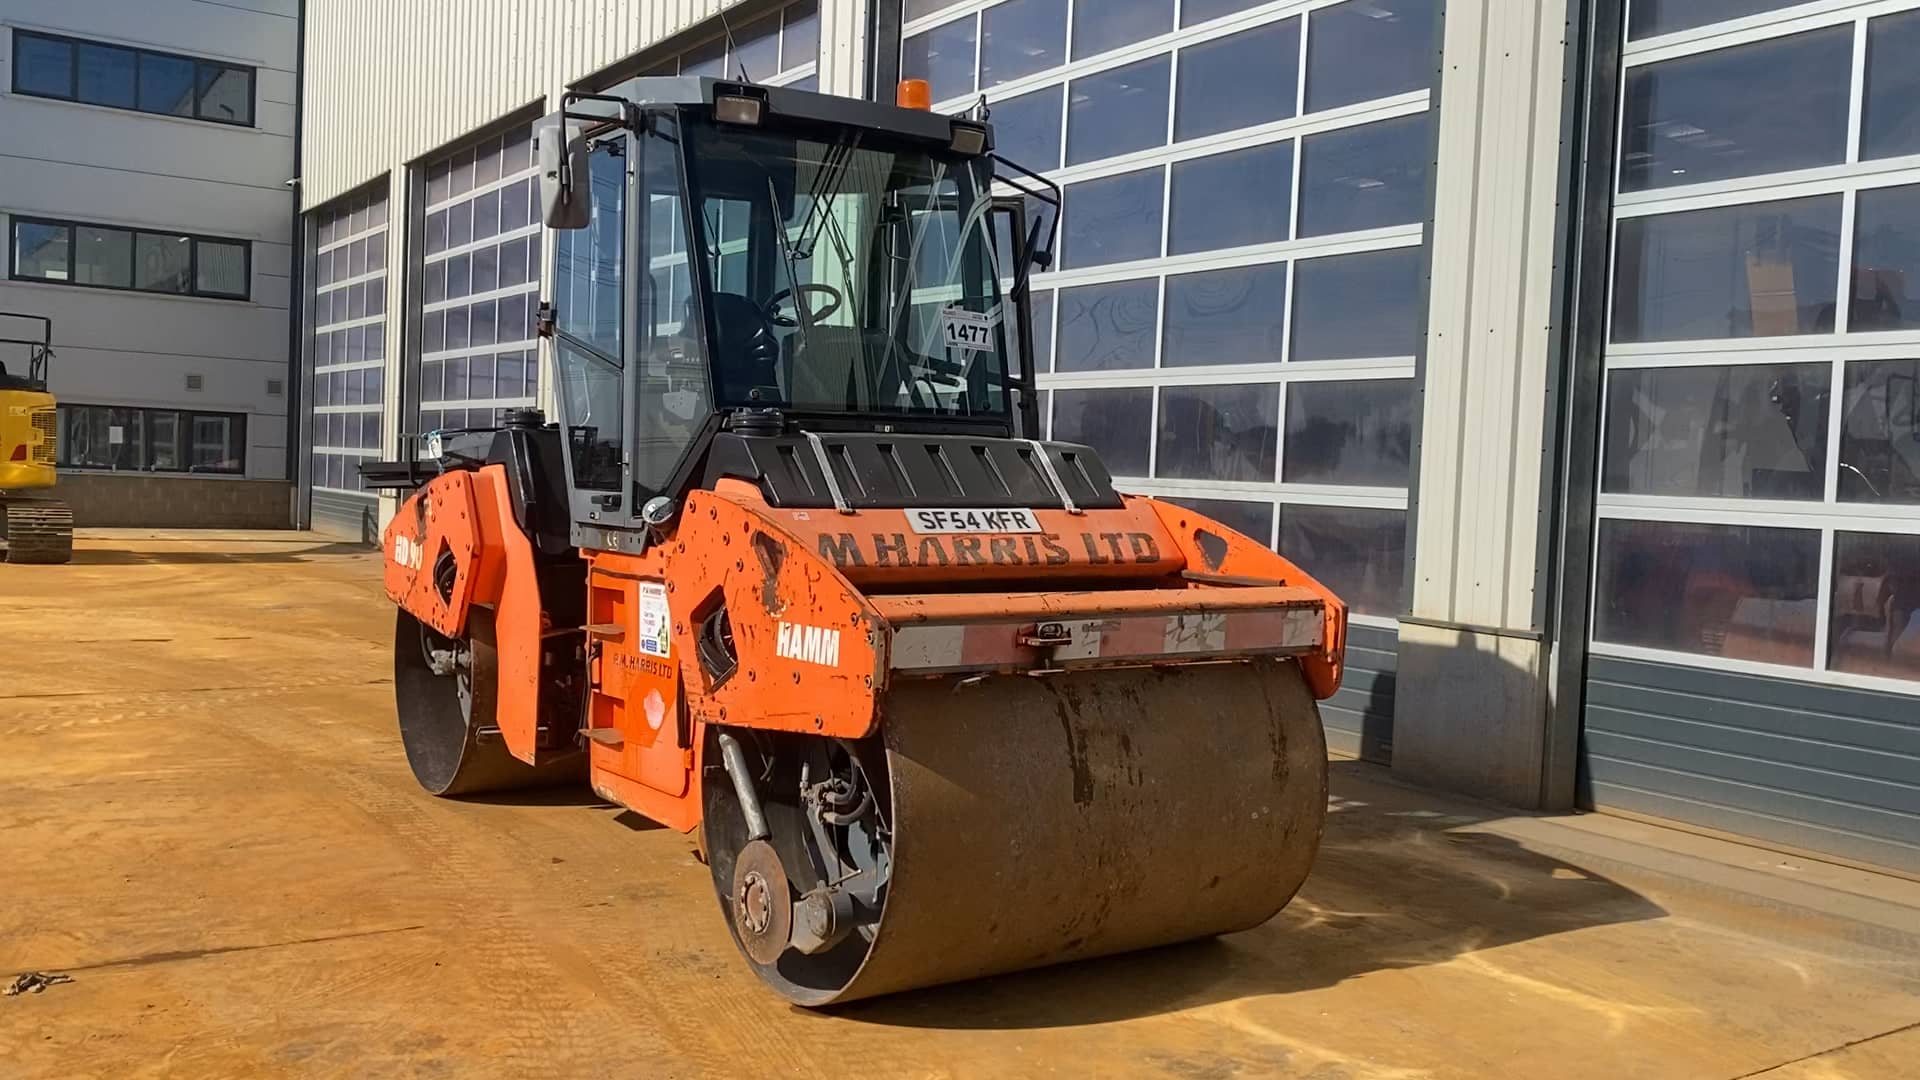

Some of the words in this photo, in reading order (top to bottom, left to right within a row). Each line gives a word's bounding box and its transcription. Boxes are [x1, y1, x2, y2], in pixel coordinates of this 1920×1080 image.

[947, 323, 988, 343] 1477
[918, 511, 981, 530] SF54
[982, 511, 1032, 530] KFR
[872, 532, 1070, 567] HARRIS
[1080, 532, 1161, 565] LTD
[776, 621, 840, 667] HAMM
[629, 656, 658, 675] HARRIS
[658, 663, 673, 679] LTD
